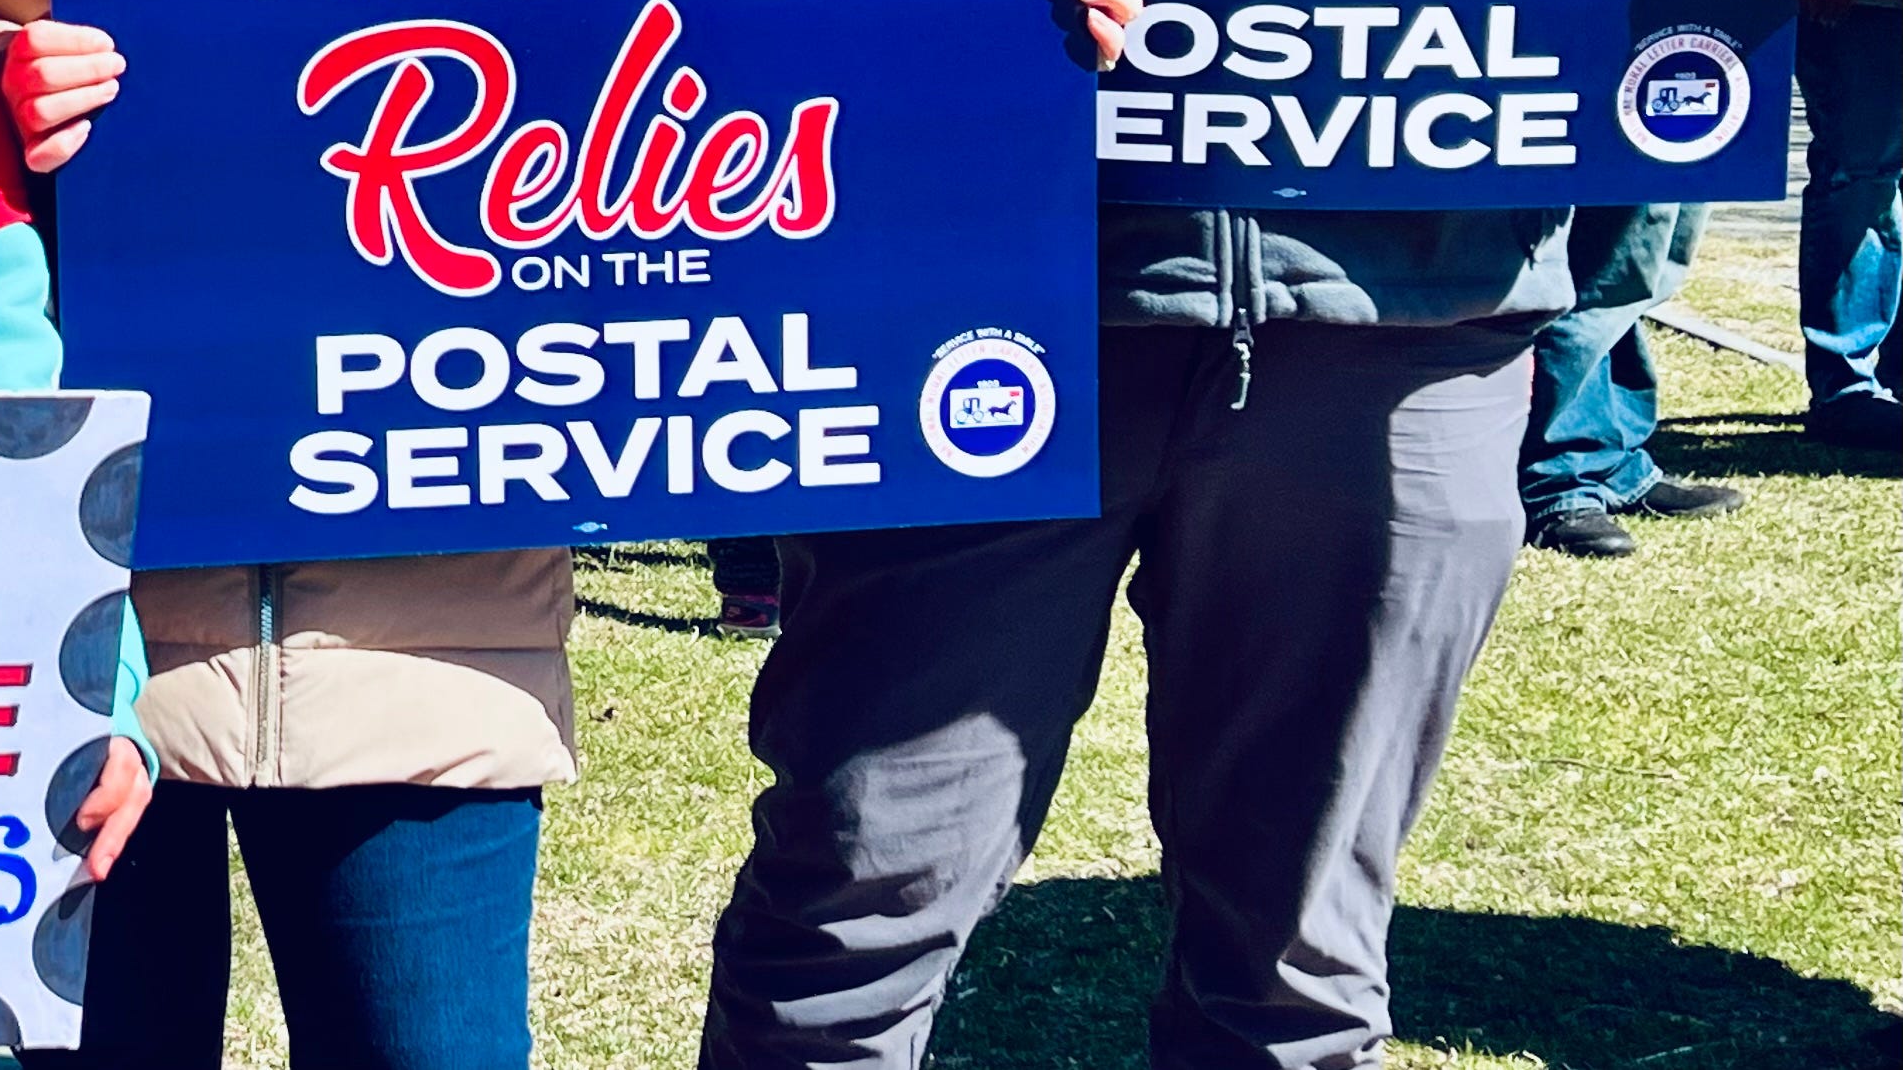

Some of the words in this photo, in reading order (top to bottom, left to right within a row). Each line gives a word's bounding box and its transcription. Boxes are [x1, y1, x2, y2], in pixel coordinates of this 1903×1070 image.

[1124, 3, 1559, 80] OSTAL
[1096, 91, 1579, 170] ERVICE
[511, 252, 591, 291] ON
[602, 247, 712, 286] THE
[316, 312, 858, 415] POSTAL
[288, 404, 881, 514] SERVICE
